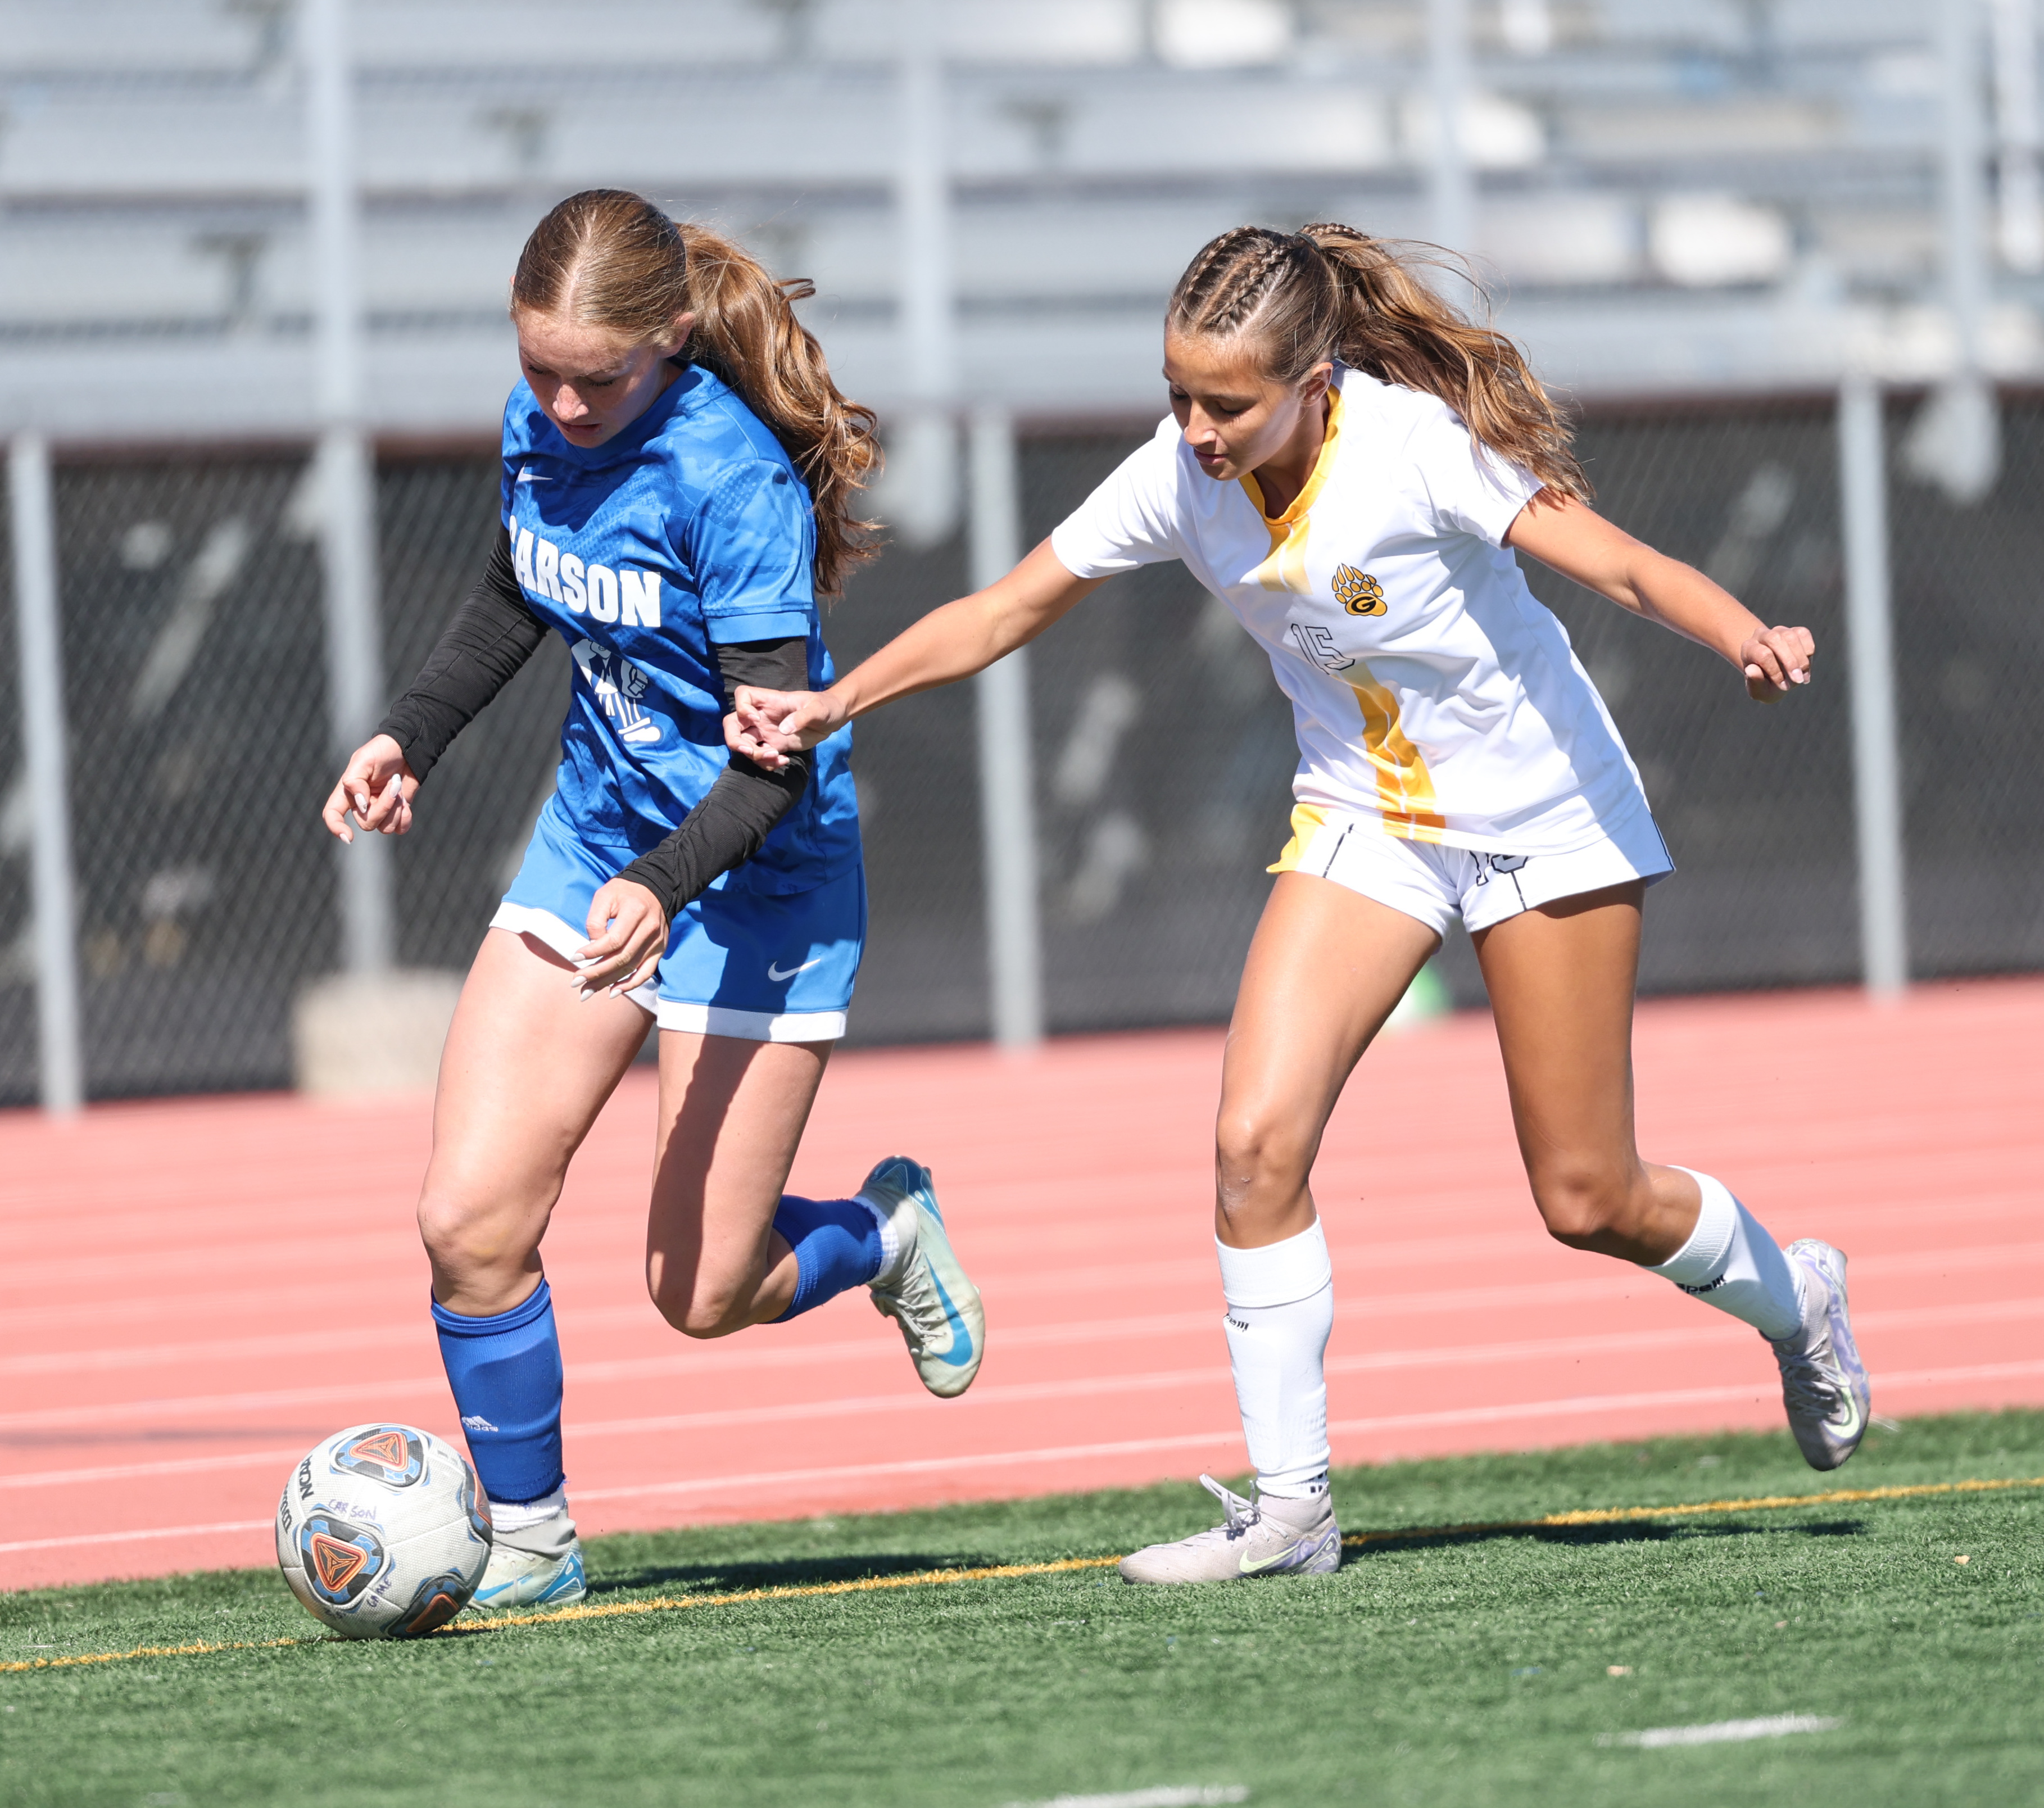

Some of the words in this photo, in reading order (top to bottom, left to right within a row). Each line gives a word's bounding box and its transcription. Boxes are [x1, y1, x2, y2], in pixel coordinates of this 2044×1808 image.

[1351, 596, 1376, 613] G
[1291, 623, 1356, 674] 15
[299, 1454, 315, 1501] NCAA
